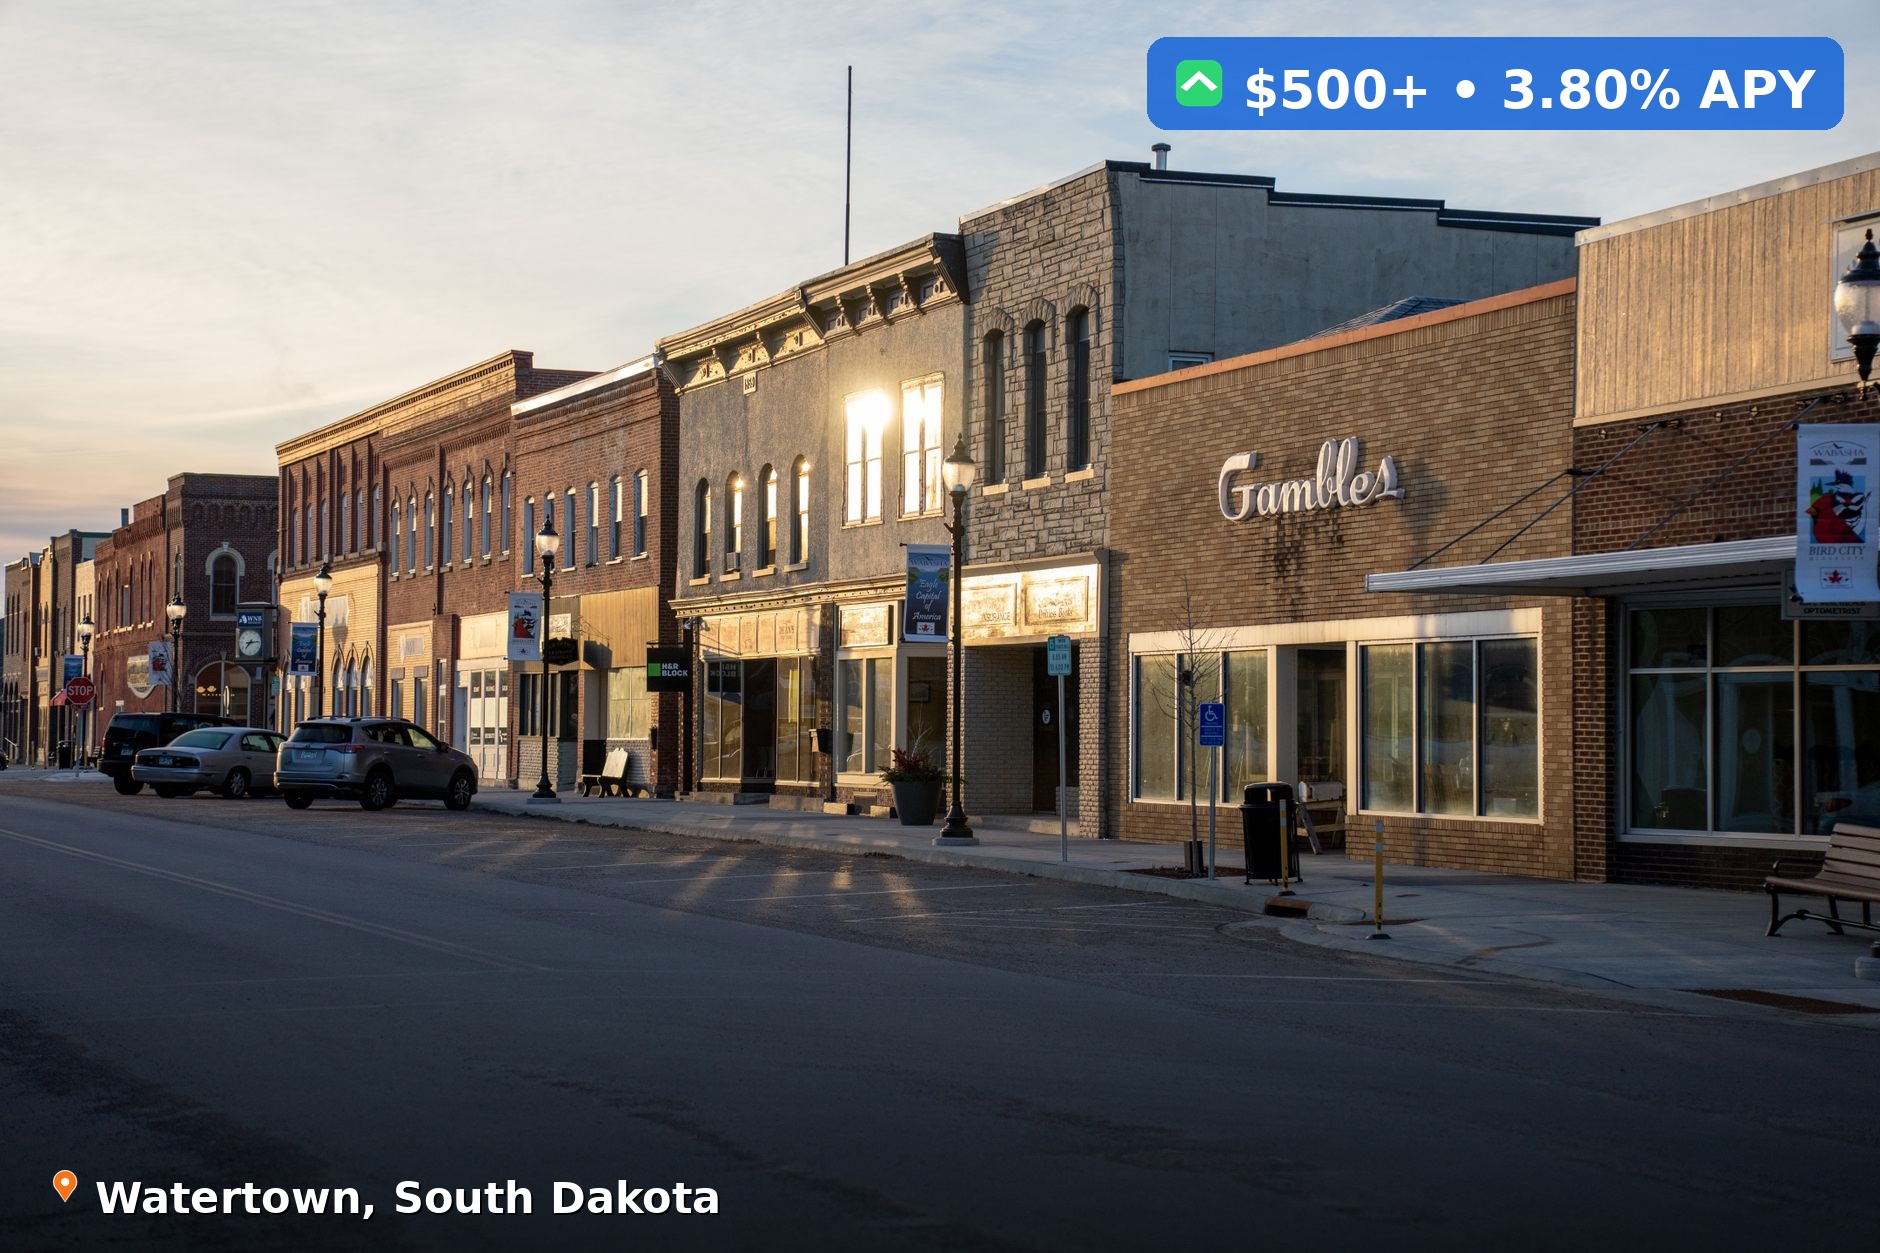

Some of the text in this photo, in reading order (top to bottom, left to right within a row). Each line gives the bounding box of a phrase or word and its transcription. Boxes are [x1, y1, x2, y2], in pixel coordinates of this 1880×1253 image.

[1218, 436, 1405, 522] Gambles
[1808, 546, 1865, 556] BIRD CITY
[916, 590, 942, 604] Capital
[924, 600, 933, 611] of
[912, 612, 942, 620] America
[1803, 607, 1862, 615] OPTOMETRIST
[661, 662, 679, 670] H&R
[68, 685, 94, 696] STOP
